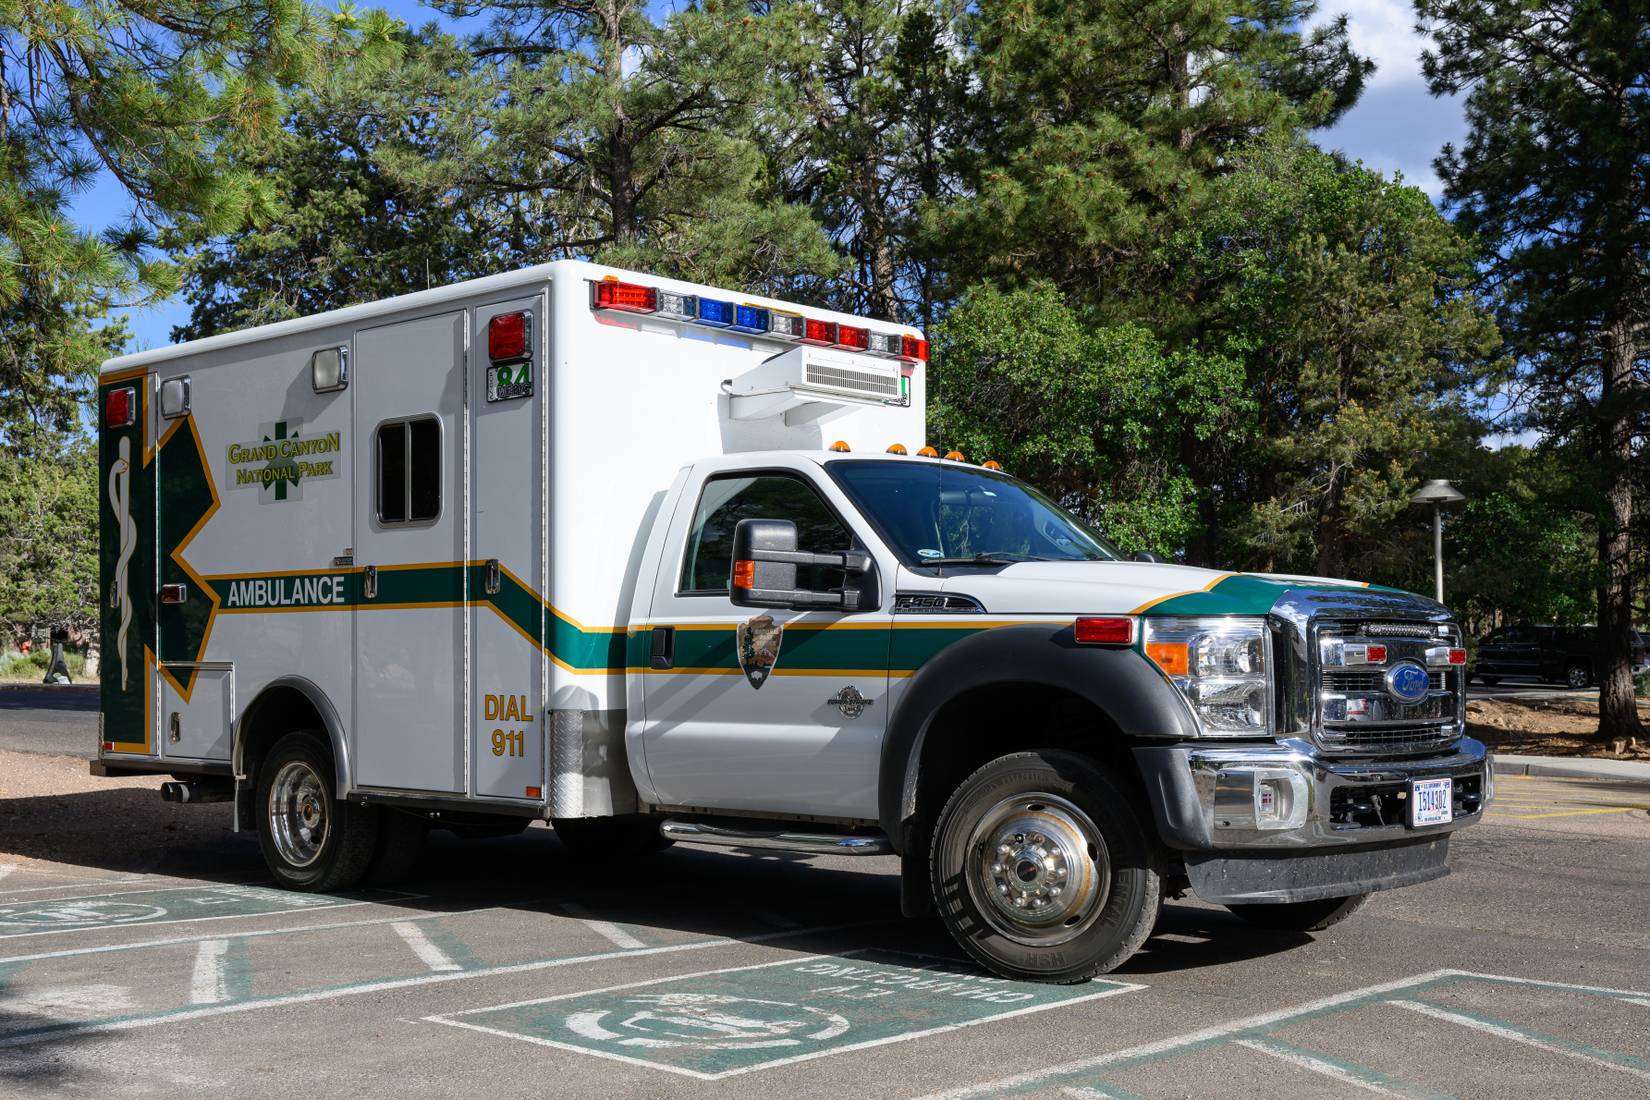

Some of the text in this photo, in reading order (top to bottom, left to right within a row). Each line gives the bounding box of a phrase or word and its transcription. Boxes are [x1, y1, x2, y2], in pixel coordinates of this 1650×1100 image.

[228, 431, 340, 464] GRAND CANYON
[236, 460, 333, 485] NATIONAL PARK
[227, 576, 345, 606] AMBULANCE
[1401, 668, 1425, 692] Ford
[484, 694, 534, 722] DIAL
[491, 728, 524, 757] 911
